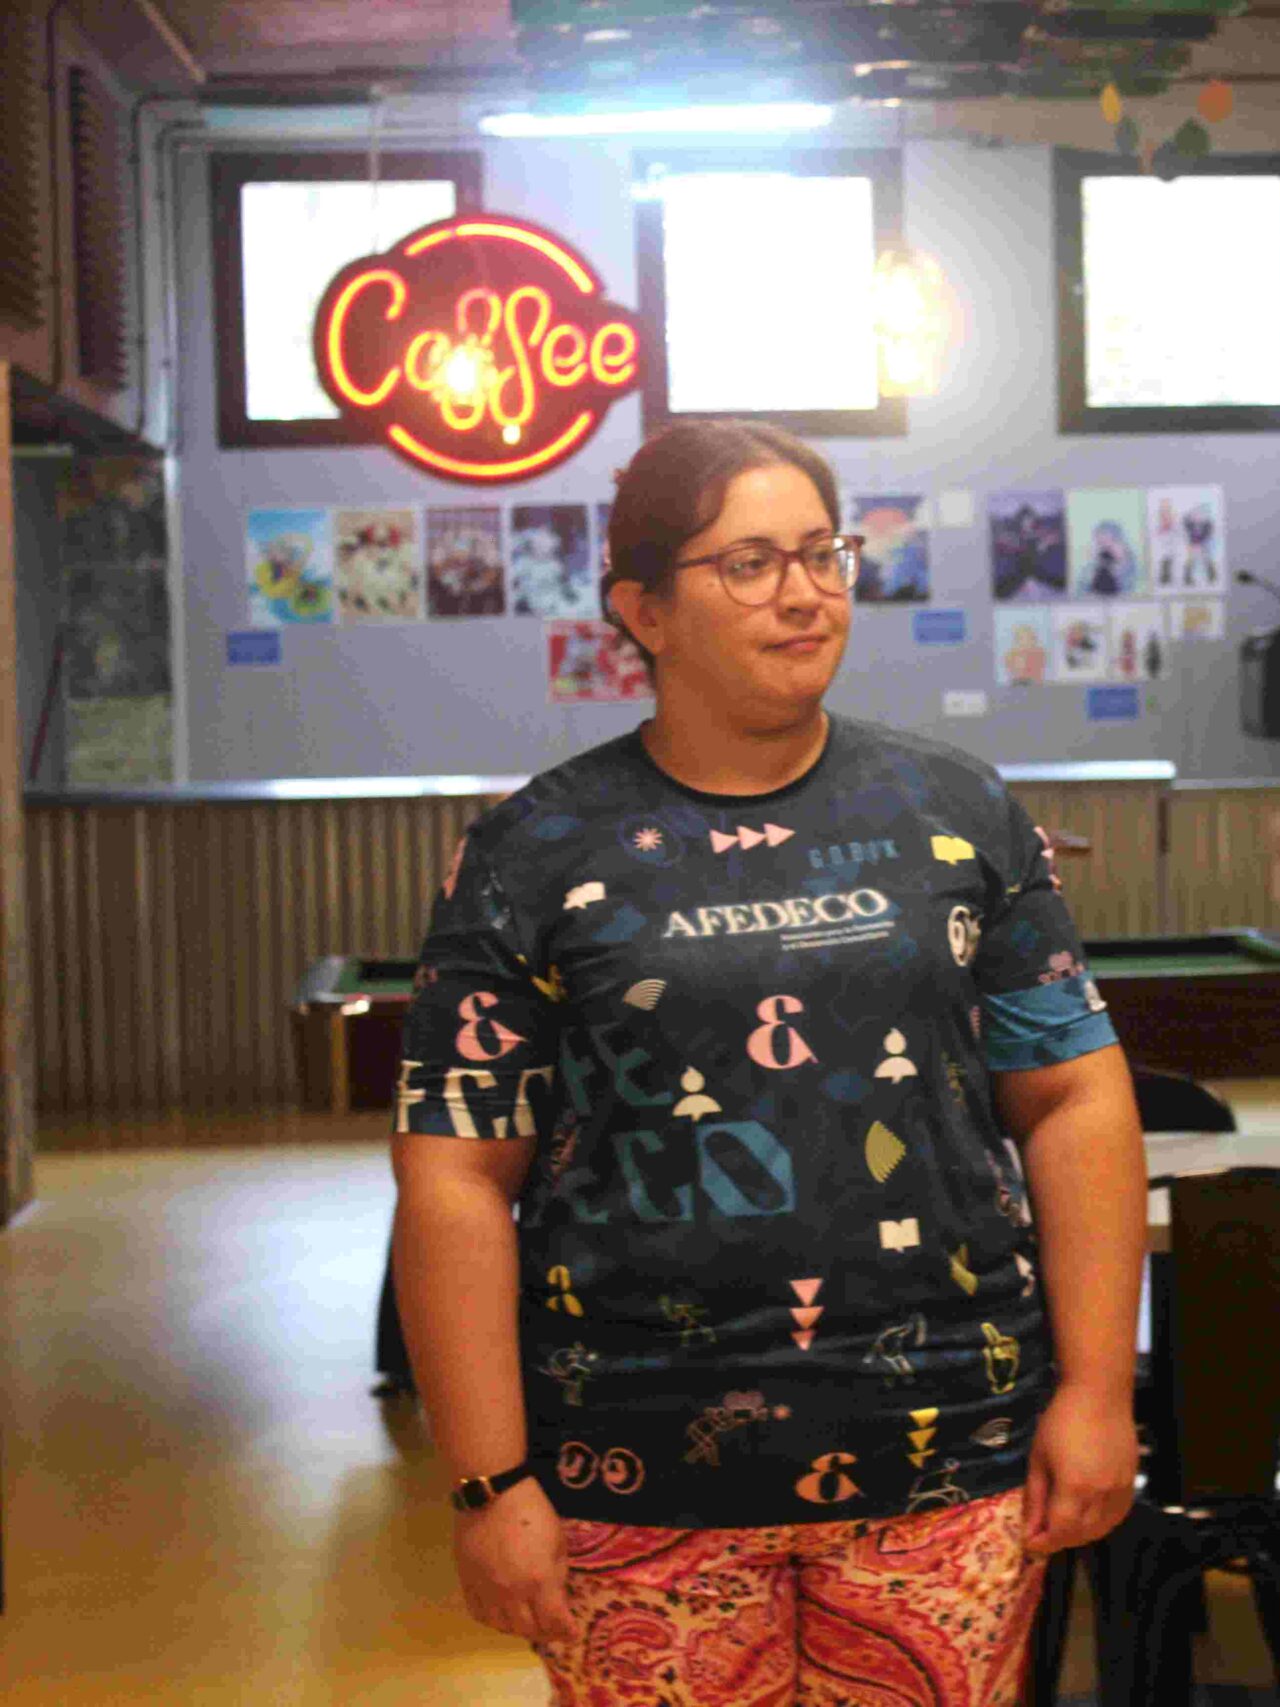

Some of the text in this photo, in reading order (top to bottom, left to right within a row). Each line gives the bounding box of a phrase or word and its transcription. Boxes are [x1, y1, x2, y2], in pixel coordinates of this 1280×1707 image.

[327, 267, 639, 432] Coffee
[661, 887, 892, 939] AFEDECO
[747, 994, 819, 1070] &
